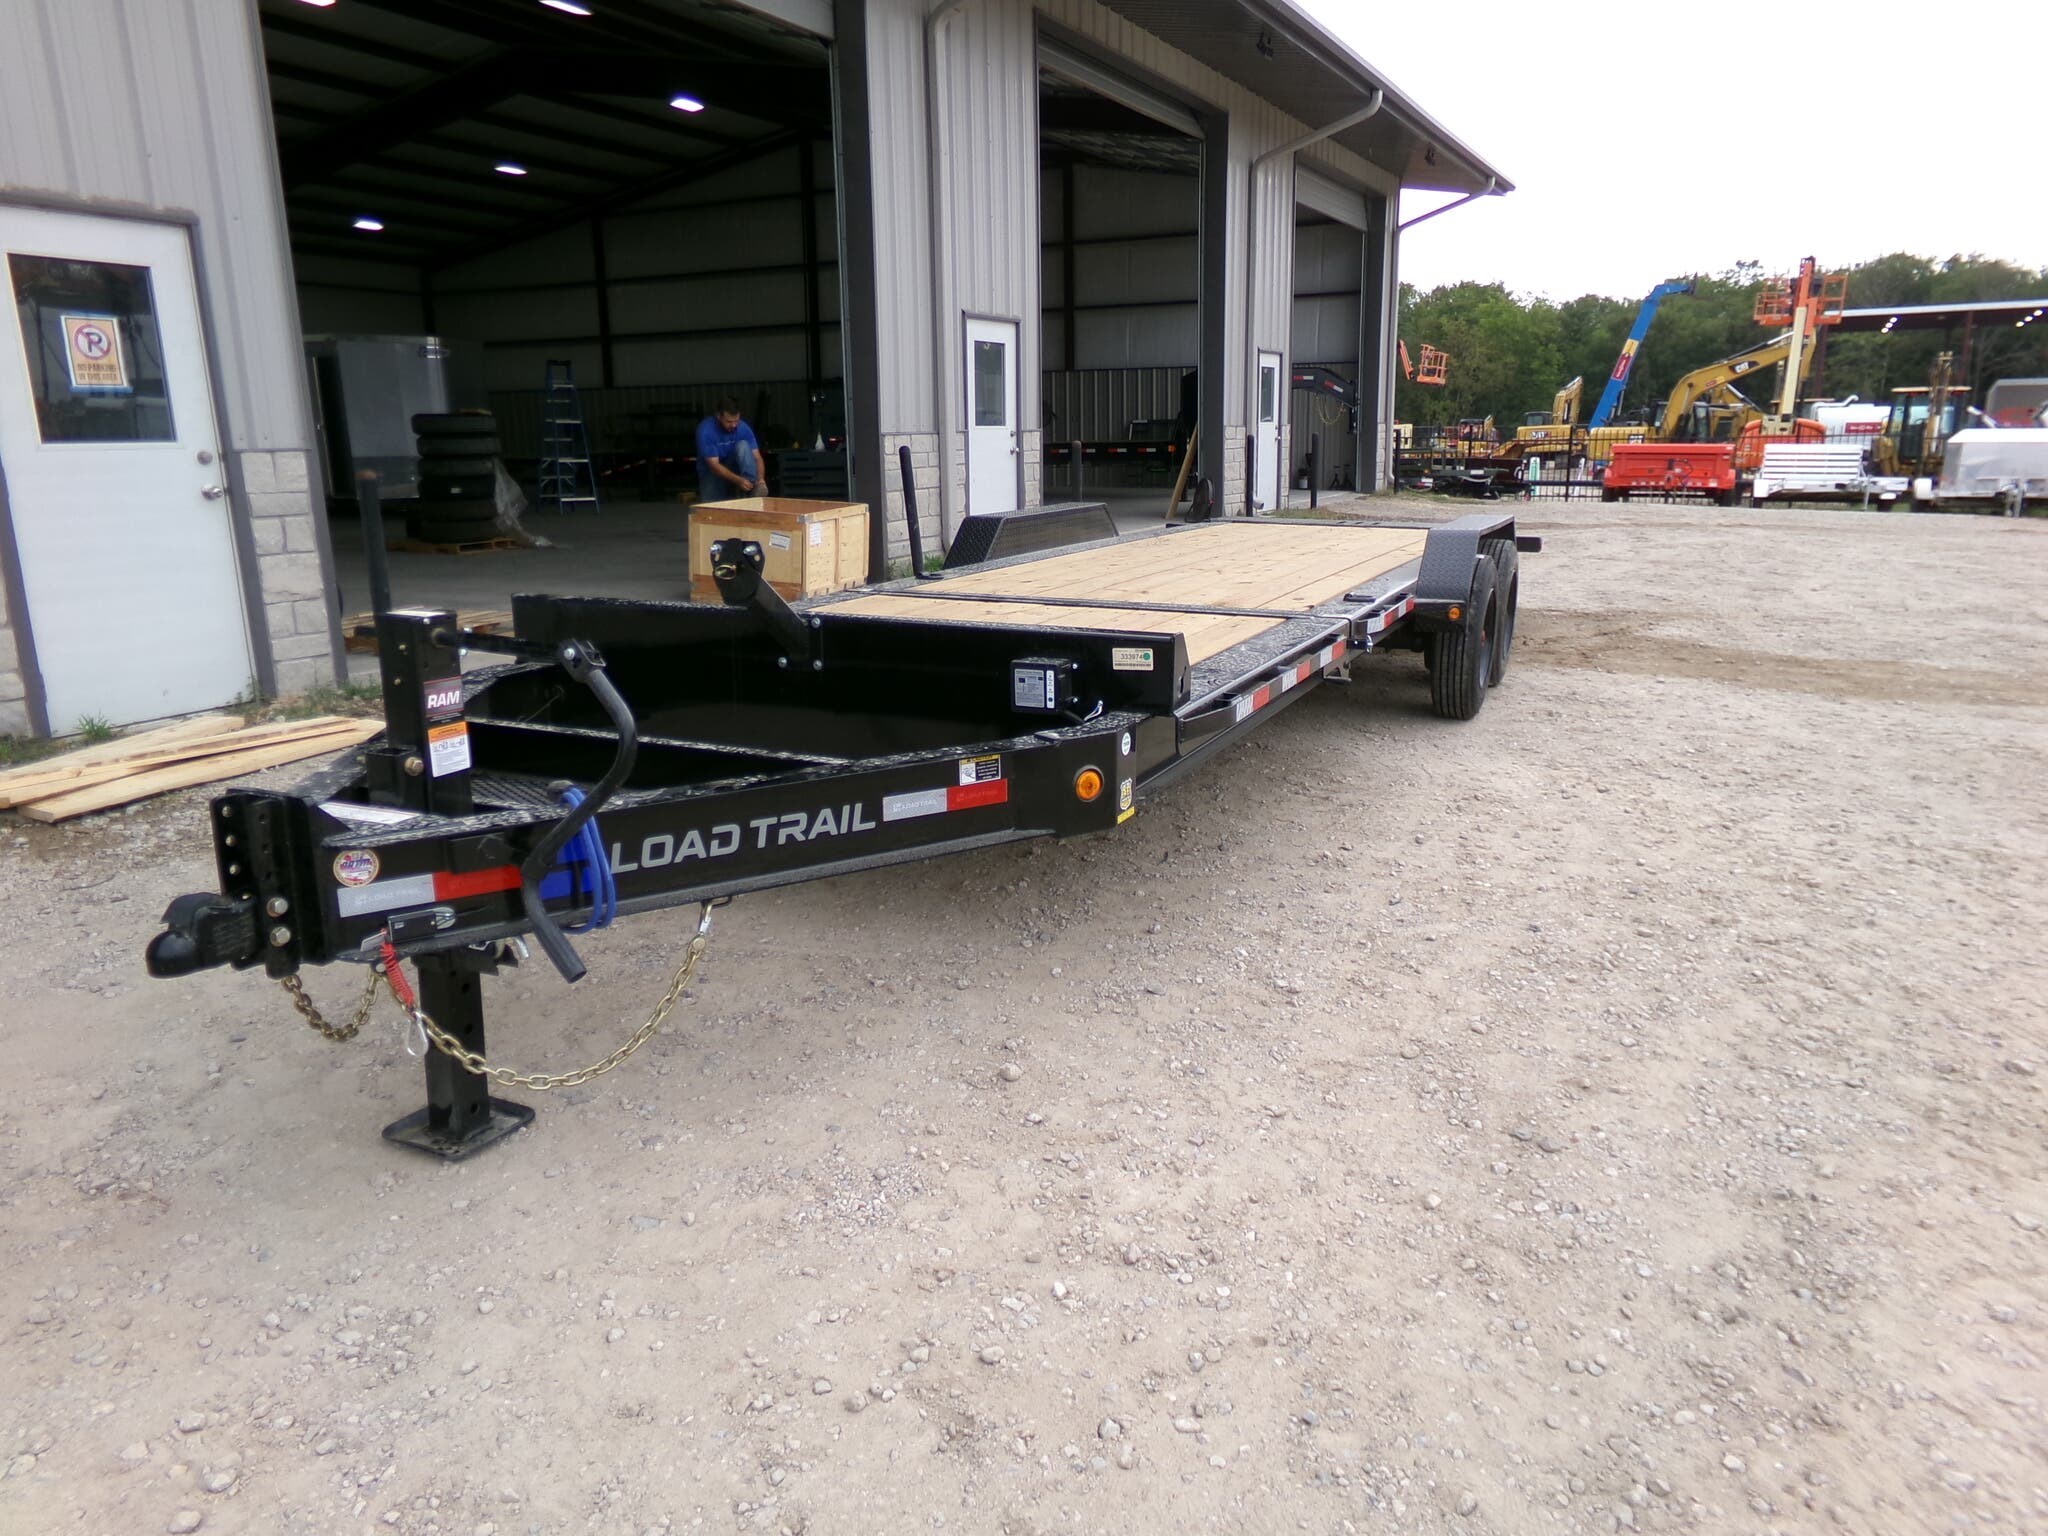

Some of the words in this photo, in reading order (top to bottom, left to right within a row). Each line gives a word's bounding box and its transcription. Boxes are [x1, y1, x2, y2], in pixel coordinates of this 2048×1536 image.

[427, 691, 460, 709] RAM
[610, 824, 741, 874] LOAD
[750, 803, 876, 848] TRAIL
